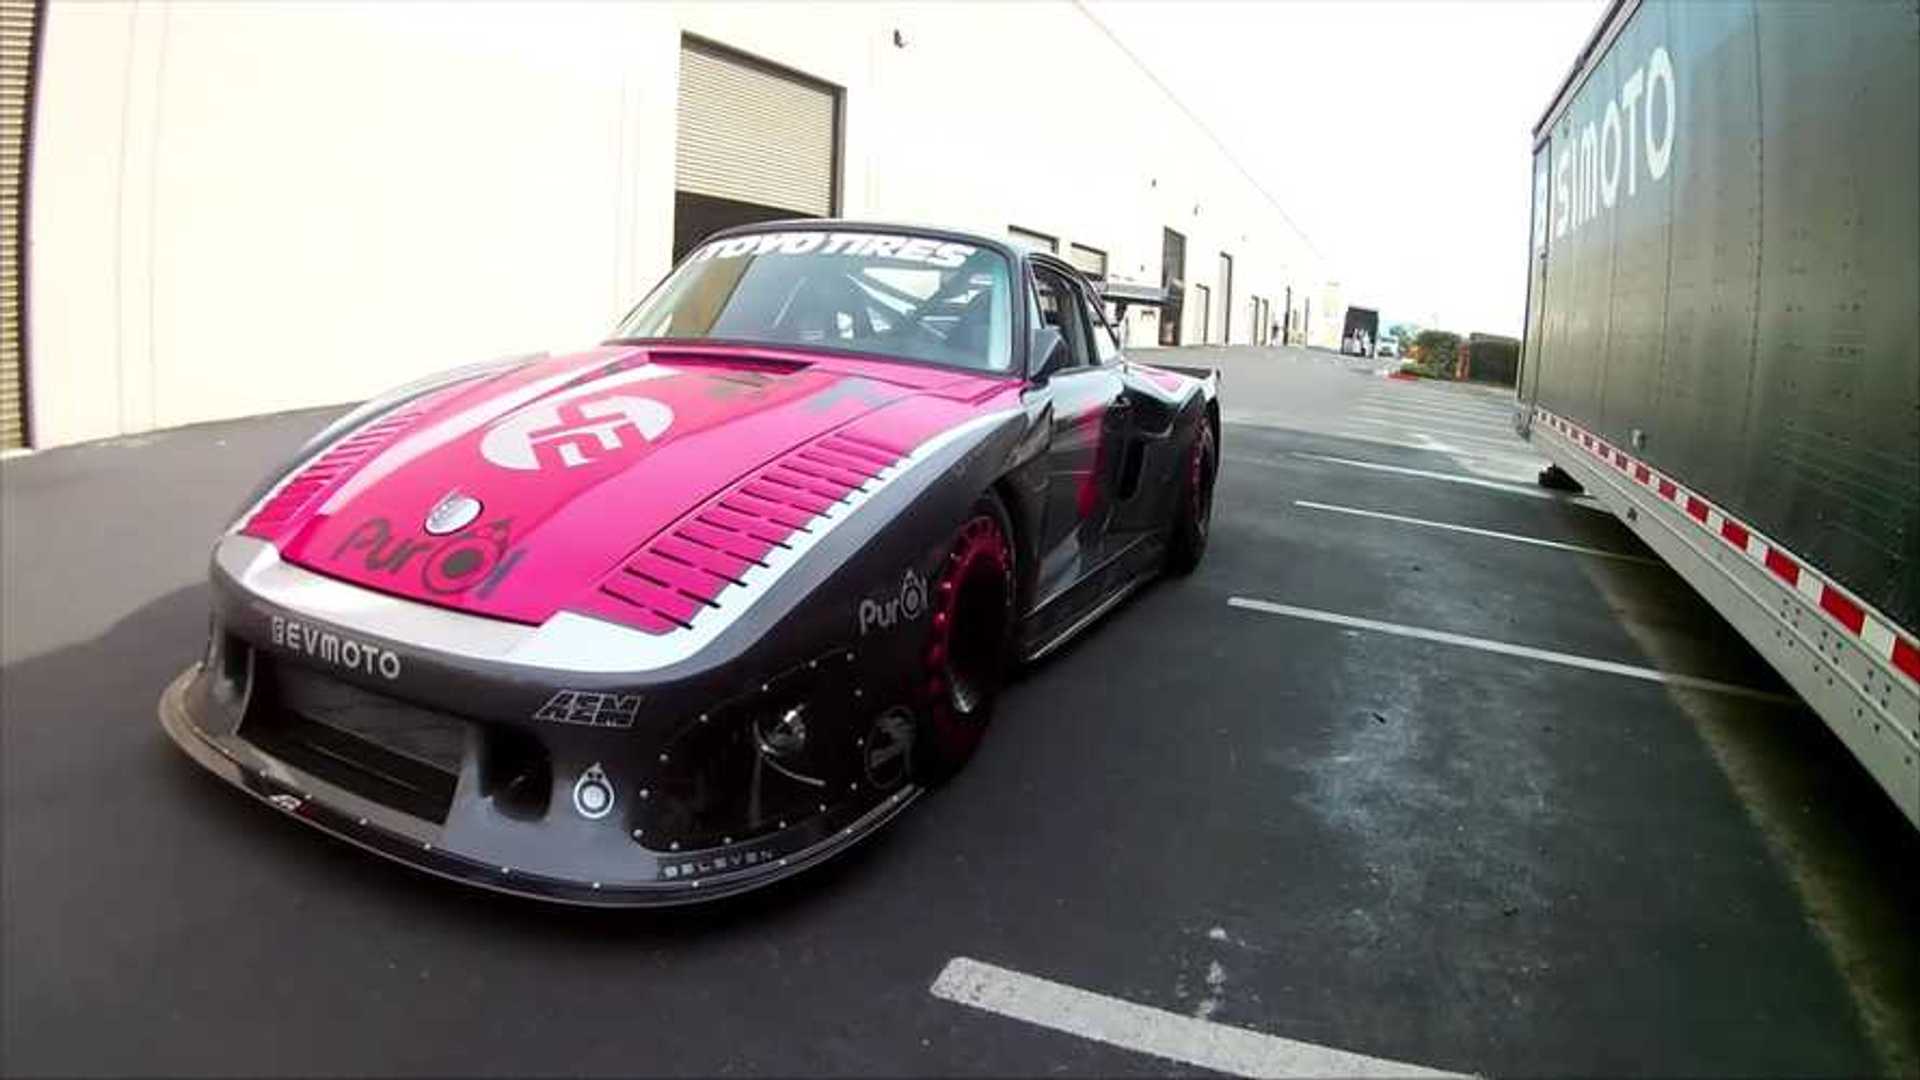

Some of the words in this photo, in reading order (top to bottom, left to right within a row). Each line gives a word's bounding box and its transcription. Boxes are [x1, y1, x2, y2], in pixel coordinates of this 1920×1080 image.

[692, 231, 827, 260] TOYO
[818, 231, 977, 268] TIRES
[534, 689, 642, 727] AEM
